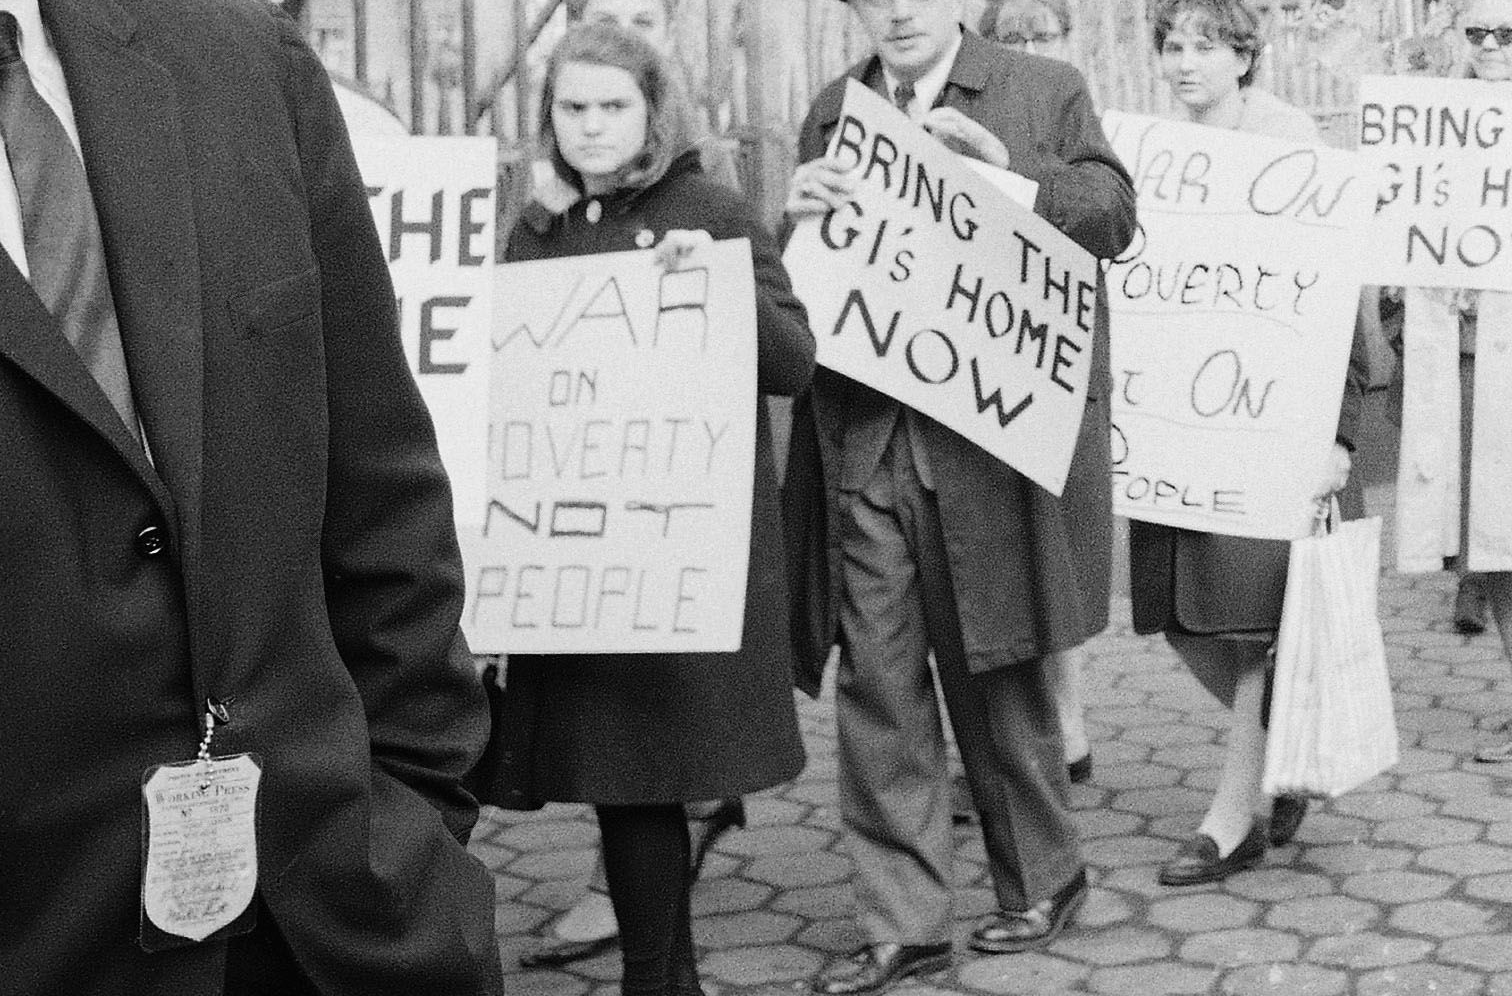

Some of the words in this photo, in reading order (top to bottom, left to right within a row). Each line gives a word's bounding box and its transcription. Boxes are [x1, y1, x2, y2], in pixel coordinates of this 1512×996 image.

[1360, 104, 1504, 149] BRING
[1247, 149, 1356, 218] ON
[834, 114, 979, 242] BRING
[1012, 230, 1096, 333] THE
[819, 201, 916, 283] GI's
[945, 263, 1083, 394] HOME
[548, 369, 597, 407] ON
[831, 288, 1034, 429] NOW
[1190, 349, 1276, 420] ON
[488, 419, 730, 480] OVERTY
[483, 499, 715, 538] NOT
[473, 565, 708, 634] PEOPLE
[214, 784, 251, 797] PRESS
